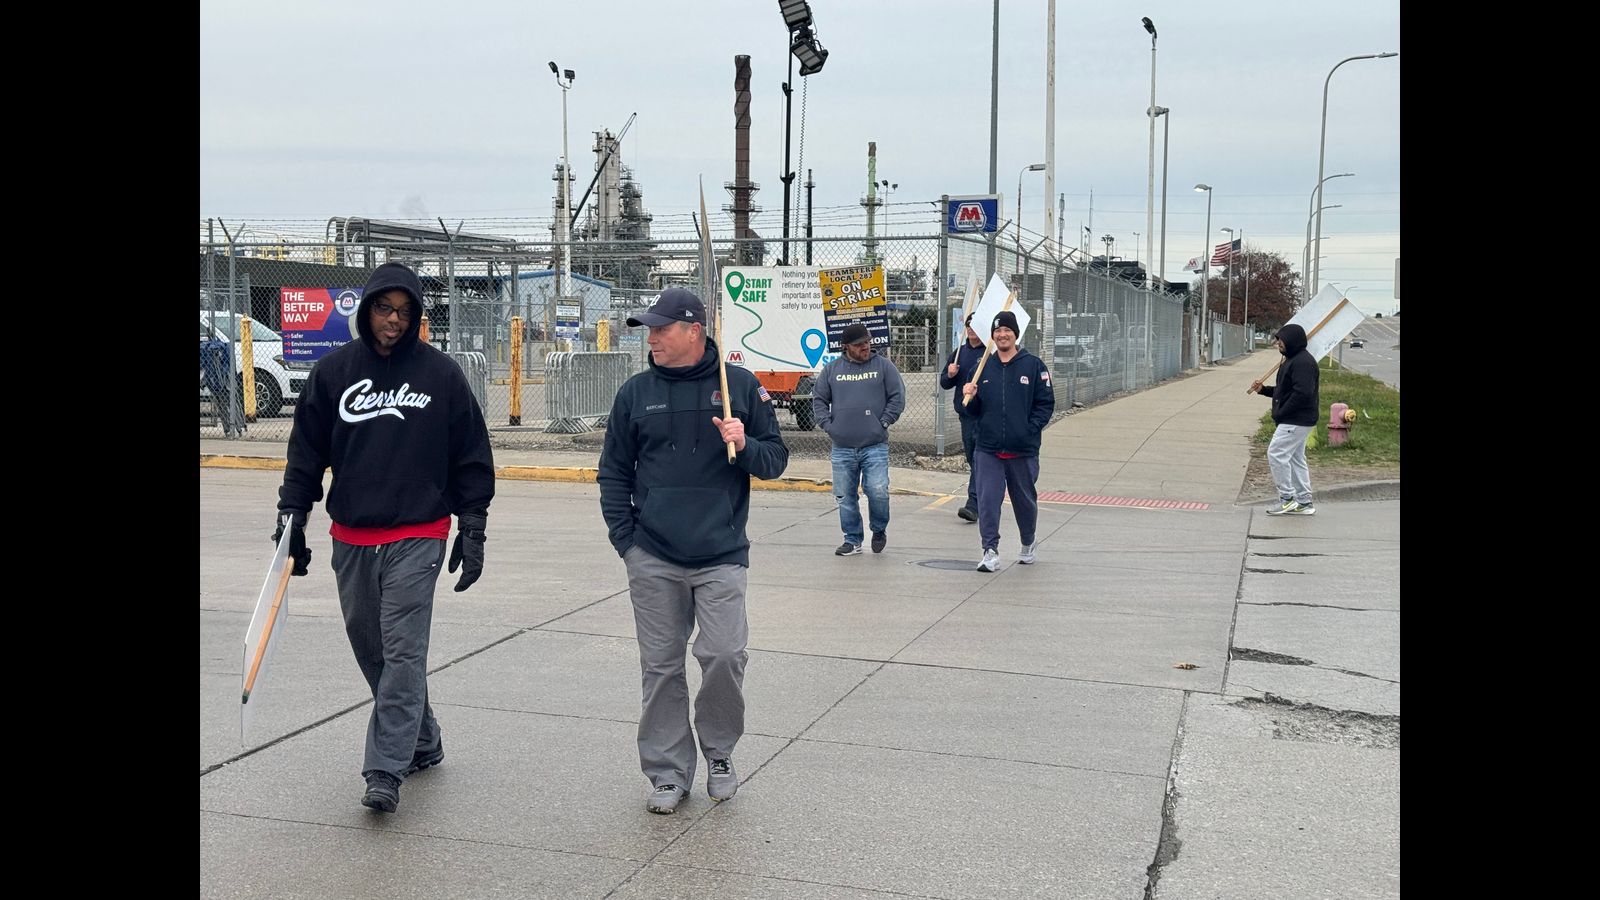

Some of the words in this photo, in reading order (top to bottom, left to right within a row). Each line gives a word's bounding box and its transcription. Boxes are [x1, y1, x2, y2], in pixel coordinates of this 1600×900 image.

[781, 271, 805, 279] Nothing
[824, 266, 877, 277] TEAMSTERS
[745, 278, 773, 289] START
[830, 275, 858, 283] LOCAL
[781, 281, 806, 289] refinery
[841, 280, 862, 294] ON
[283, 292, 304, 301] THE
[742, 290, 767, 303] SAFE
[830, 287, 880, 309] STRIKE
[284, 303, 324, 312] BETTER
[781, 302, 800, 310] safely
[284, 313, 309, 322] WAY
[836, 371, 878, 381] CARHARTT
[339, 379, 431, 422] Crenshaw
